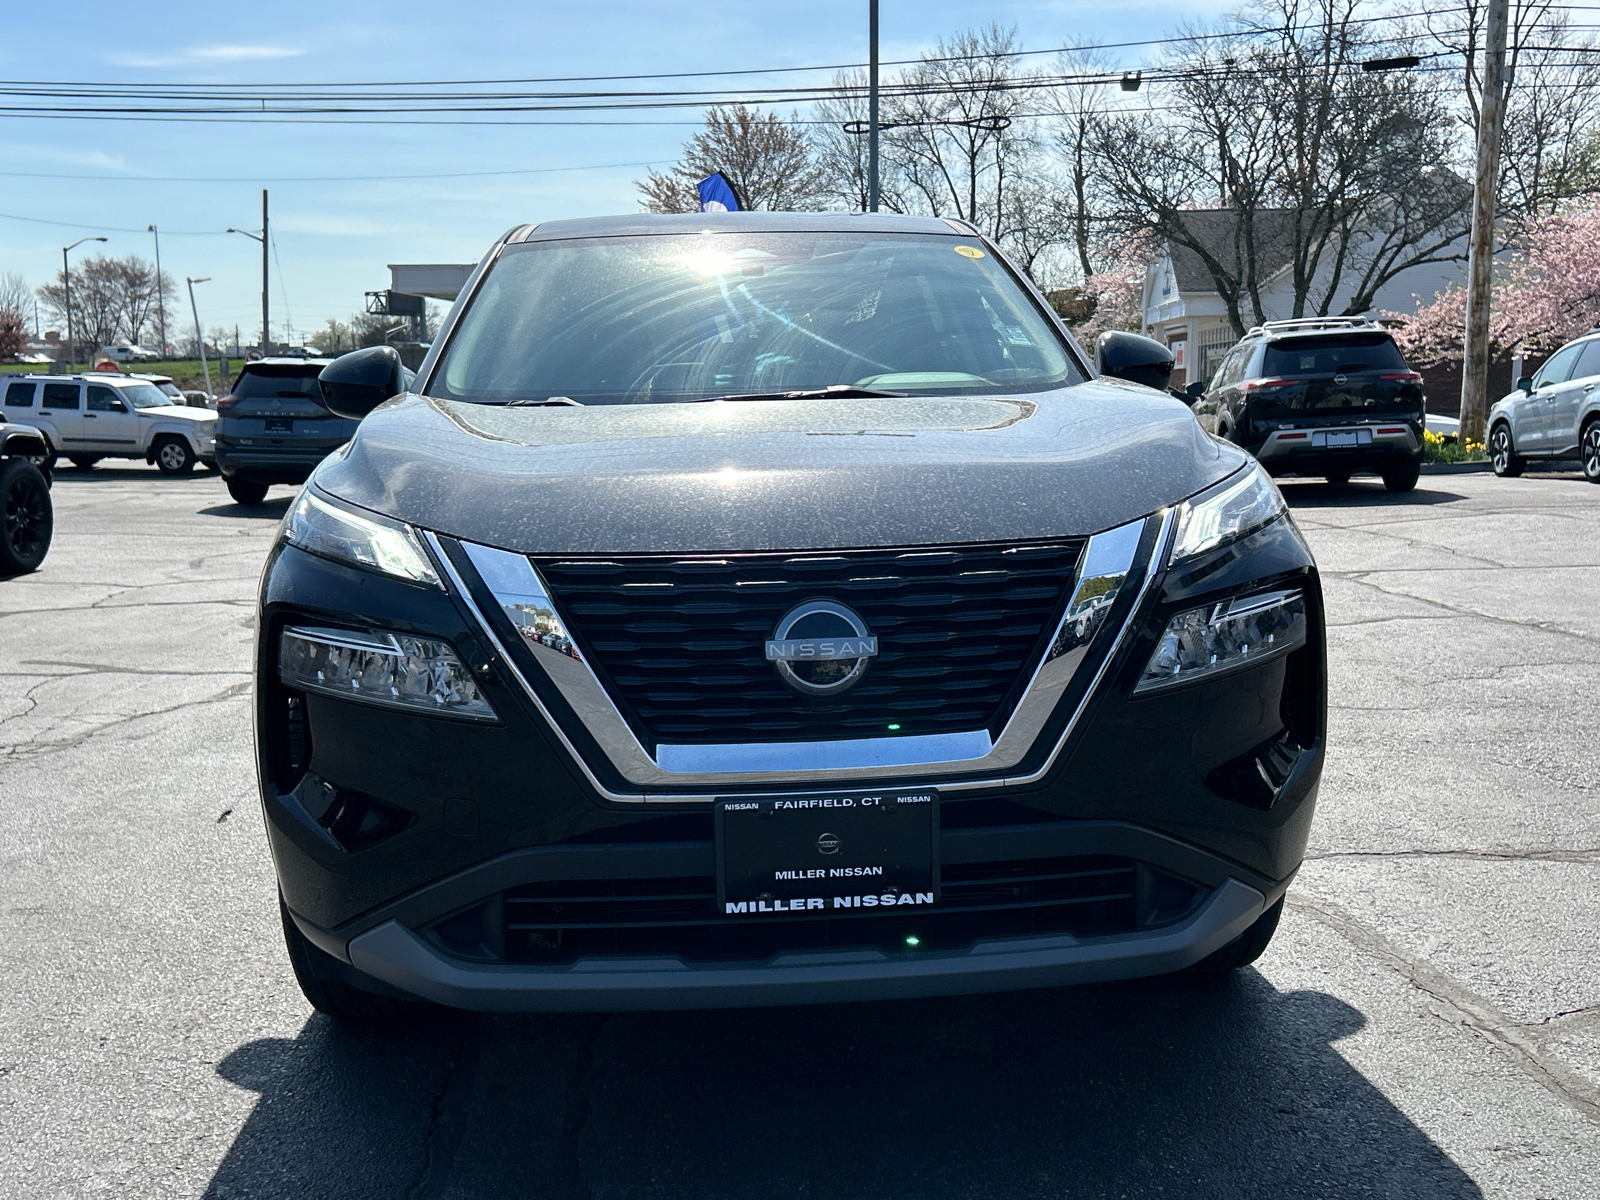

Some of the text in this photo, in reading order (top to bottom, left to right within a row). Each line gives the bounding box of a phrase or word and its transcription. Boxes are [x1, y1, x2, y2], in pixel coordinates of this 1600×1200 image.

[769, 640, 875, 657] NISSAN
[774, 797, 882, 810] FAIRFIELD, CT
[897, 795, 931, 804] NISSAN
[724, 802, 759, 811] NISSAN
[775, 866, 883, 880] MILLER NISSAN
[725, 892, 934, 914] MILLER NISSAN
